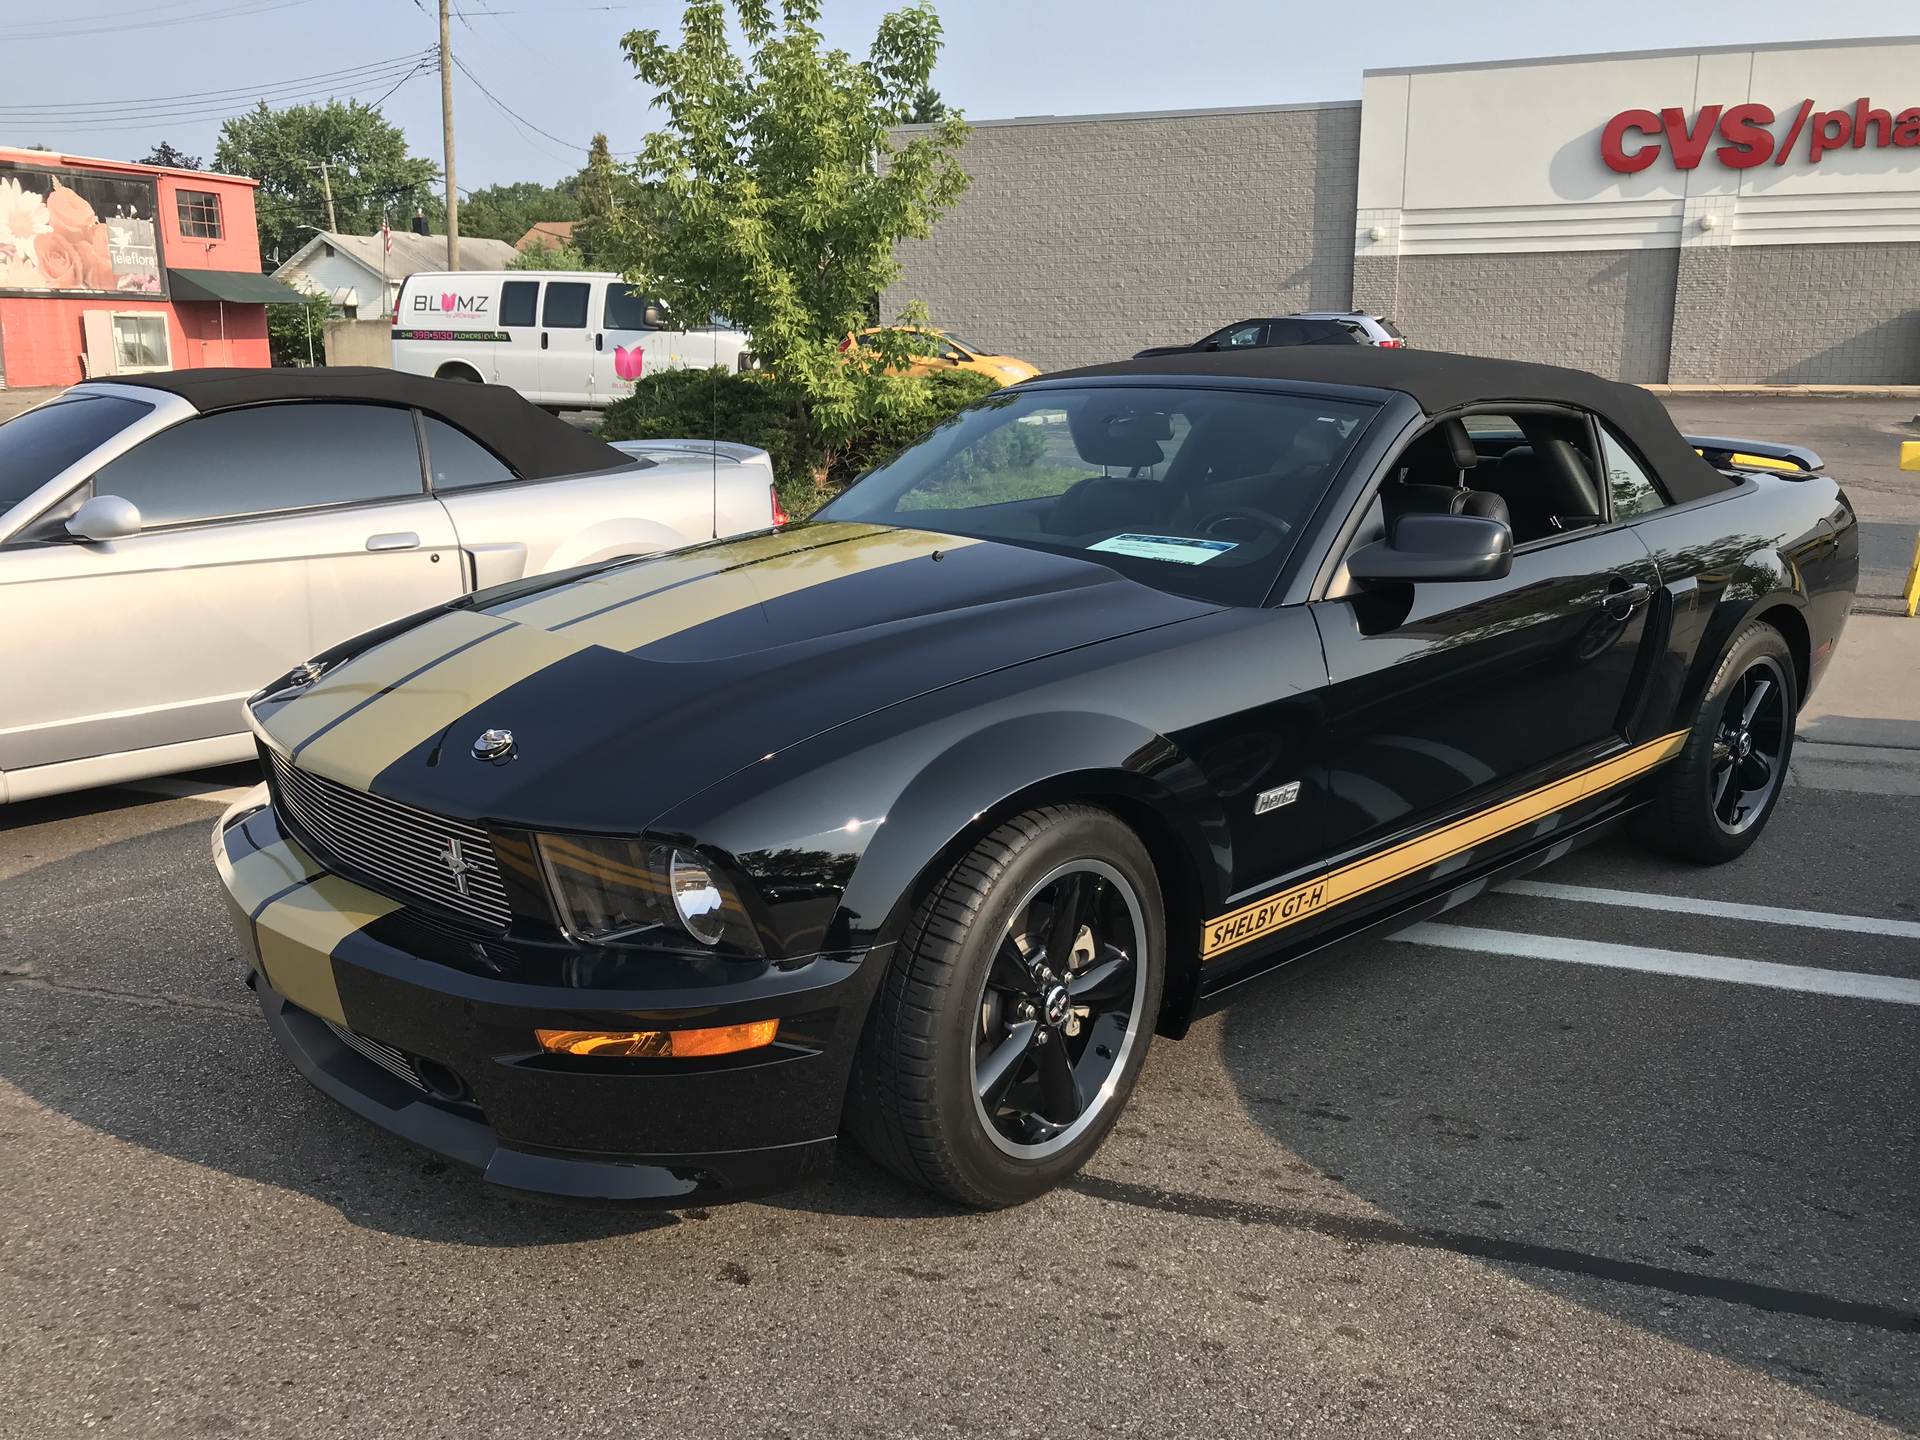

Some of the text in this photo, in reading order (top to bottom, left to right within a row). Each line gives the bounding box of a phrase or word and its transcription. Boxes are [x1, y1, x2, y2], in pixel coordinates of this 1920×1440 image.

[110, 250, 155, 268] Teleflora
[1257, 788, 1298, 812] Hertz
[1211, 885, 1324, 948] SHELBY GT-H
